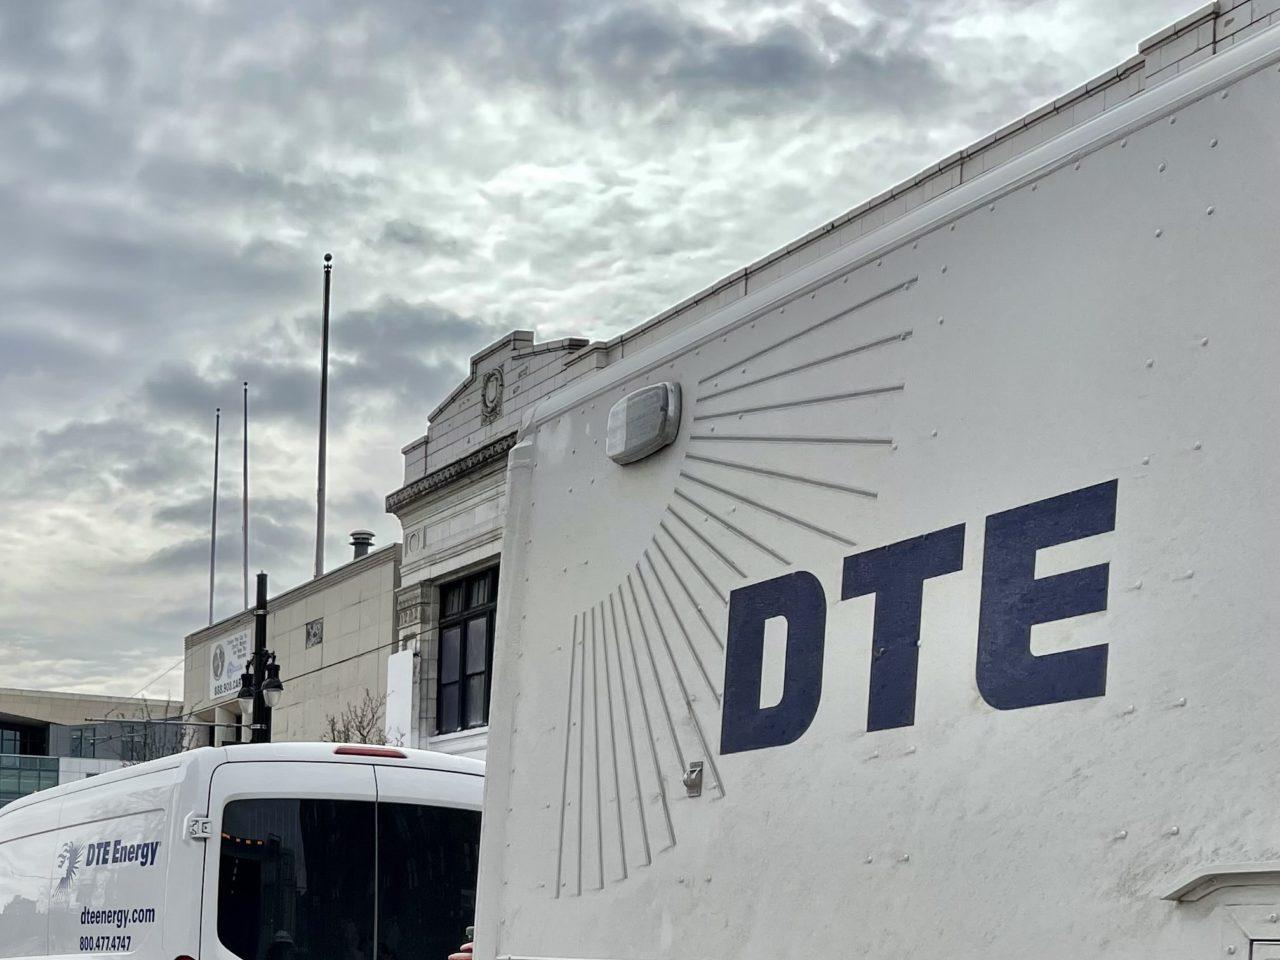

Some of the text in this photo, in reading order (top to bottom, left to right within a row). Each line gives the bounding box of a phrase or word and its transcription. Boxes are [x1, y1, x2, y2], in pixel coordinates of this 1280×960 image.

[720, 479, 1118, 755] DTE
[86, 840, 159, 867] DTE Energy
[80, 906, 155, 928] dteenergy.com
[80, 935, 131, 951] 800.477.4747
